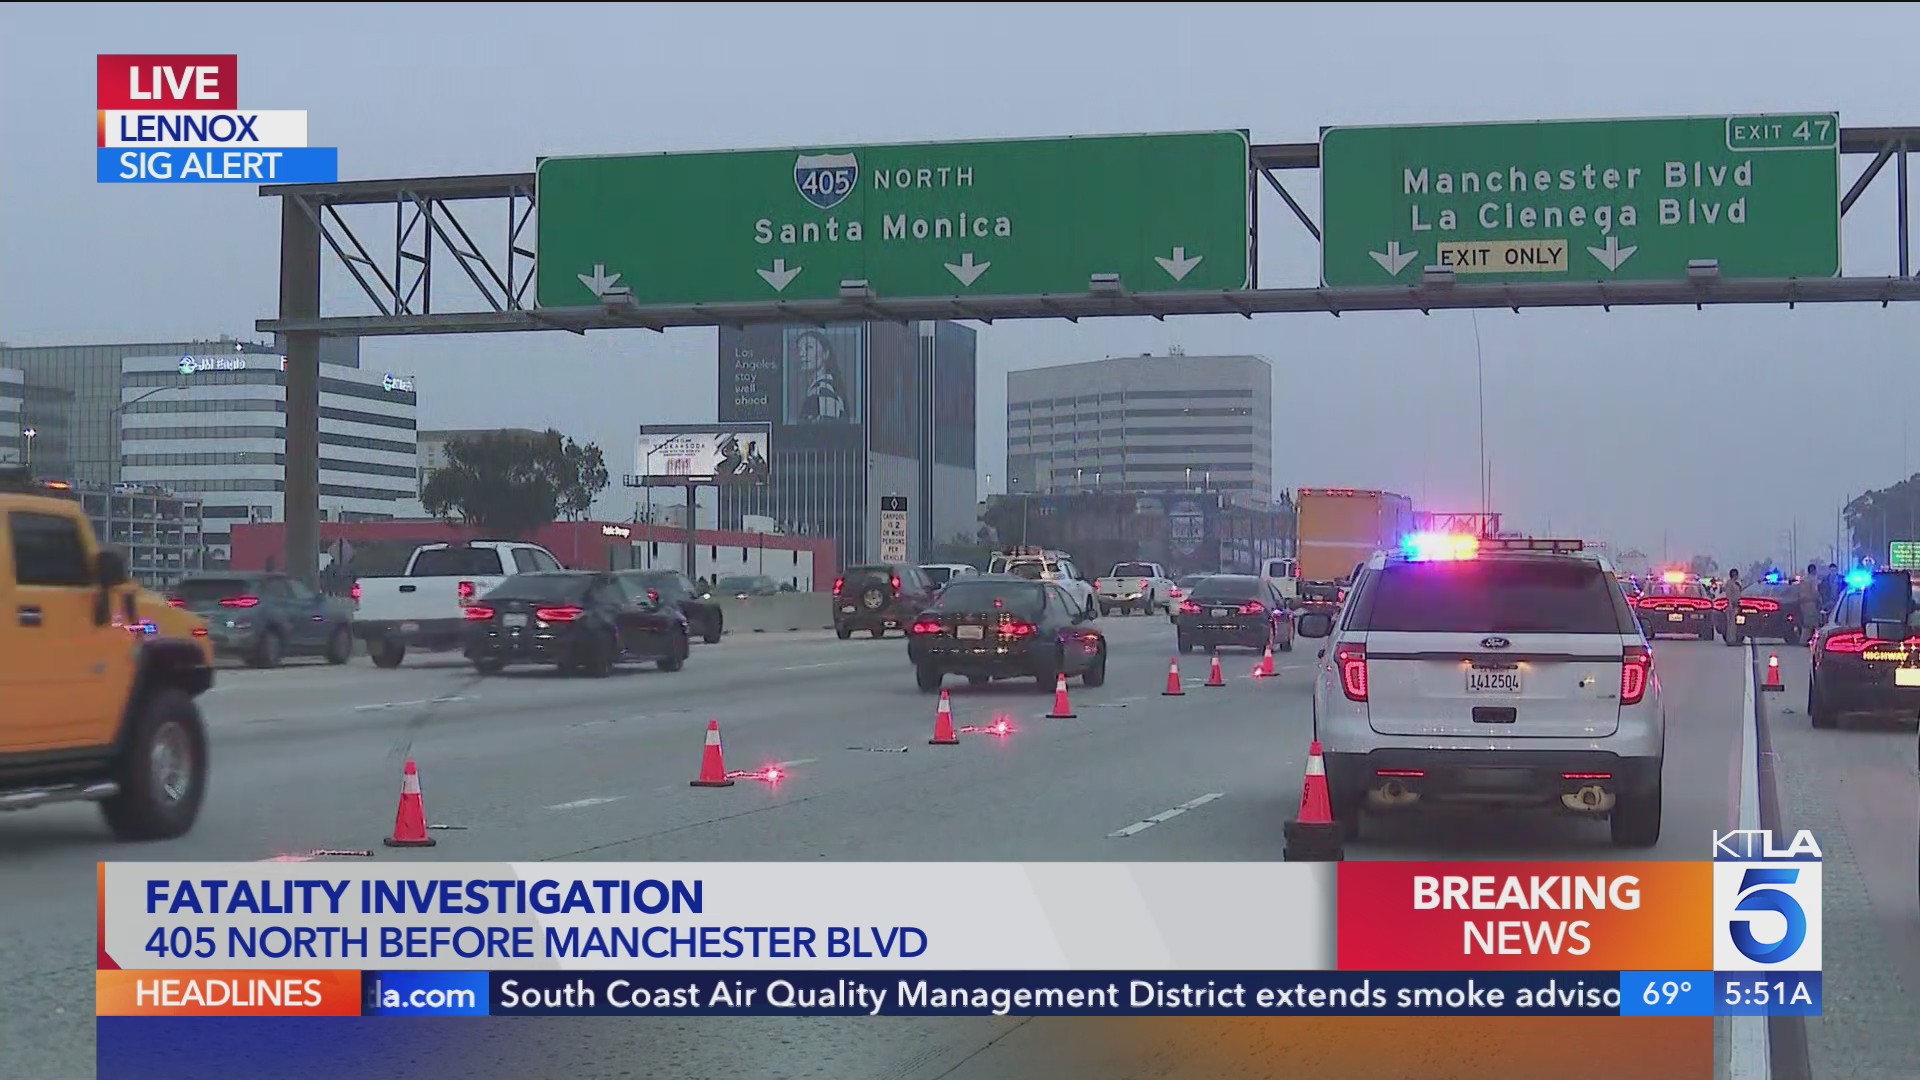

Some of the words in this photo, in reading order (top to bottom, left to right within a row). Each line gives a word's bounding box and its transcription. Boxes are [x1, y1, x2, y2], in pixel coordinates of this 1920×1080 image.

[1734, 124, 1781, 141] EXIT
[1792, 120, 1831, 141] 47
[802, 170, 850, 196] 405
[873, 166, 974, 190] NORTH
[1404, 163, 1641, 194] Manchester
[1665, 160, 1753, 187] Blvd
[1411, 205, 1457, 231] La
[1479, 199, 1637, 235] Cienega
[1659, 197, 1746, 225] Blvd
[754, 215, 863, 244] Santa
[883, 212, 1012, 240] Monica
[1441, 248, 1490, 268] EXIT
[1505, 246, 1563, 267] ONLY
[735, 360, 777, 371] Angeles
[895, 521, 900, 529] 2
[1863, 651, 1909, 661] HIGHWAY
[1470, 674, 1519, 689] 1412504
